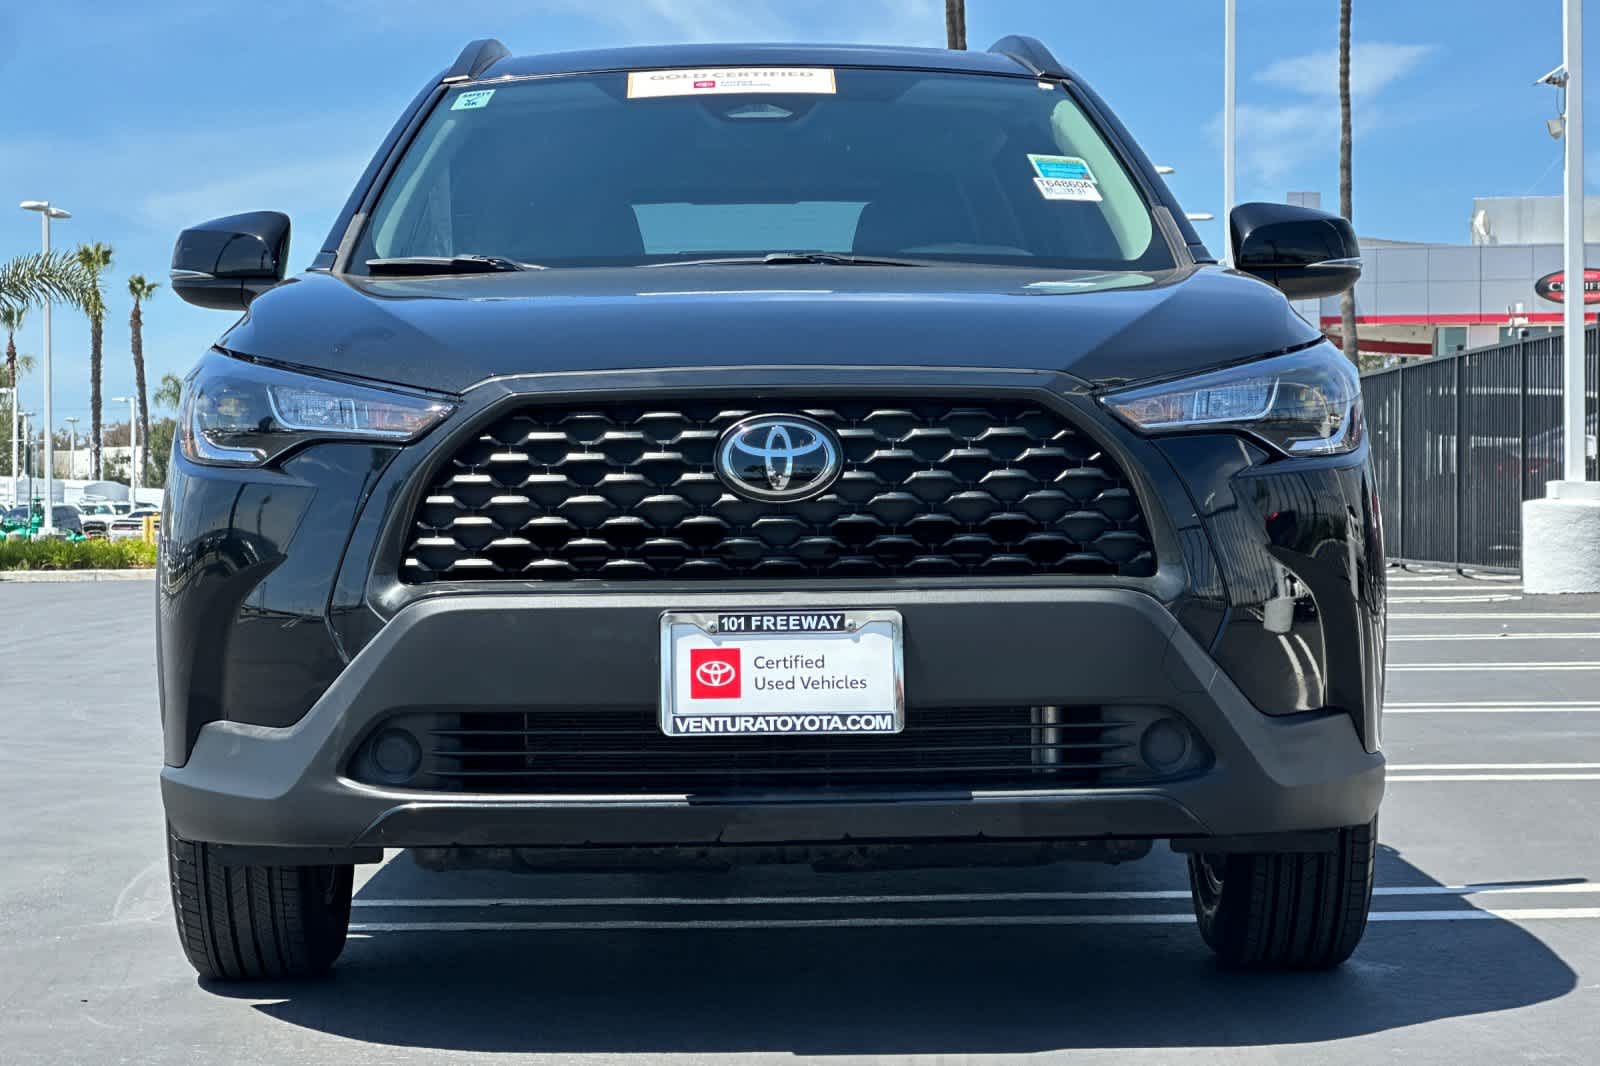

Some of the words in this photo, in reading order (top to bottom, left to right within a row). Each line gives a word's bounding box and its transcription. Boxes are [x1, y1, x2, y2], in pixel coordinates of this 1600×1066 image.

[650, 73, 708, 81] GOLD
[712, 71, 814, 79] CERTIFIED
[721, 616, 745, 631] 101
[751, 615, 842, 630] FREEWAY
[753, 654, 825, 669] Certified
[754, 677, 795, 690] Used
[800, 675, 867, 690] Vehicles
[675, 714, 892, 732] VENTURATOYOTA.COM
